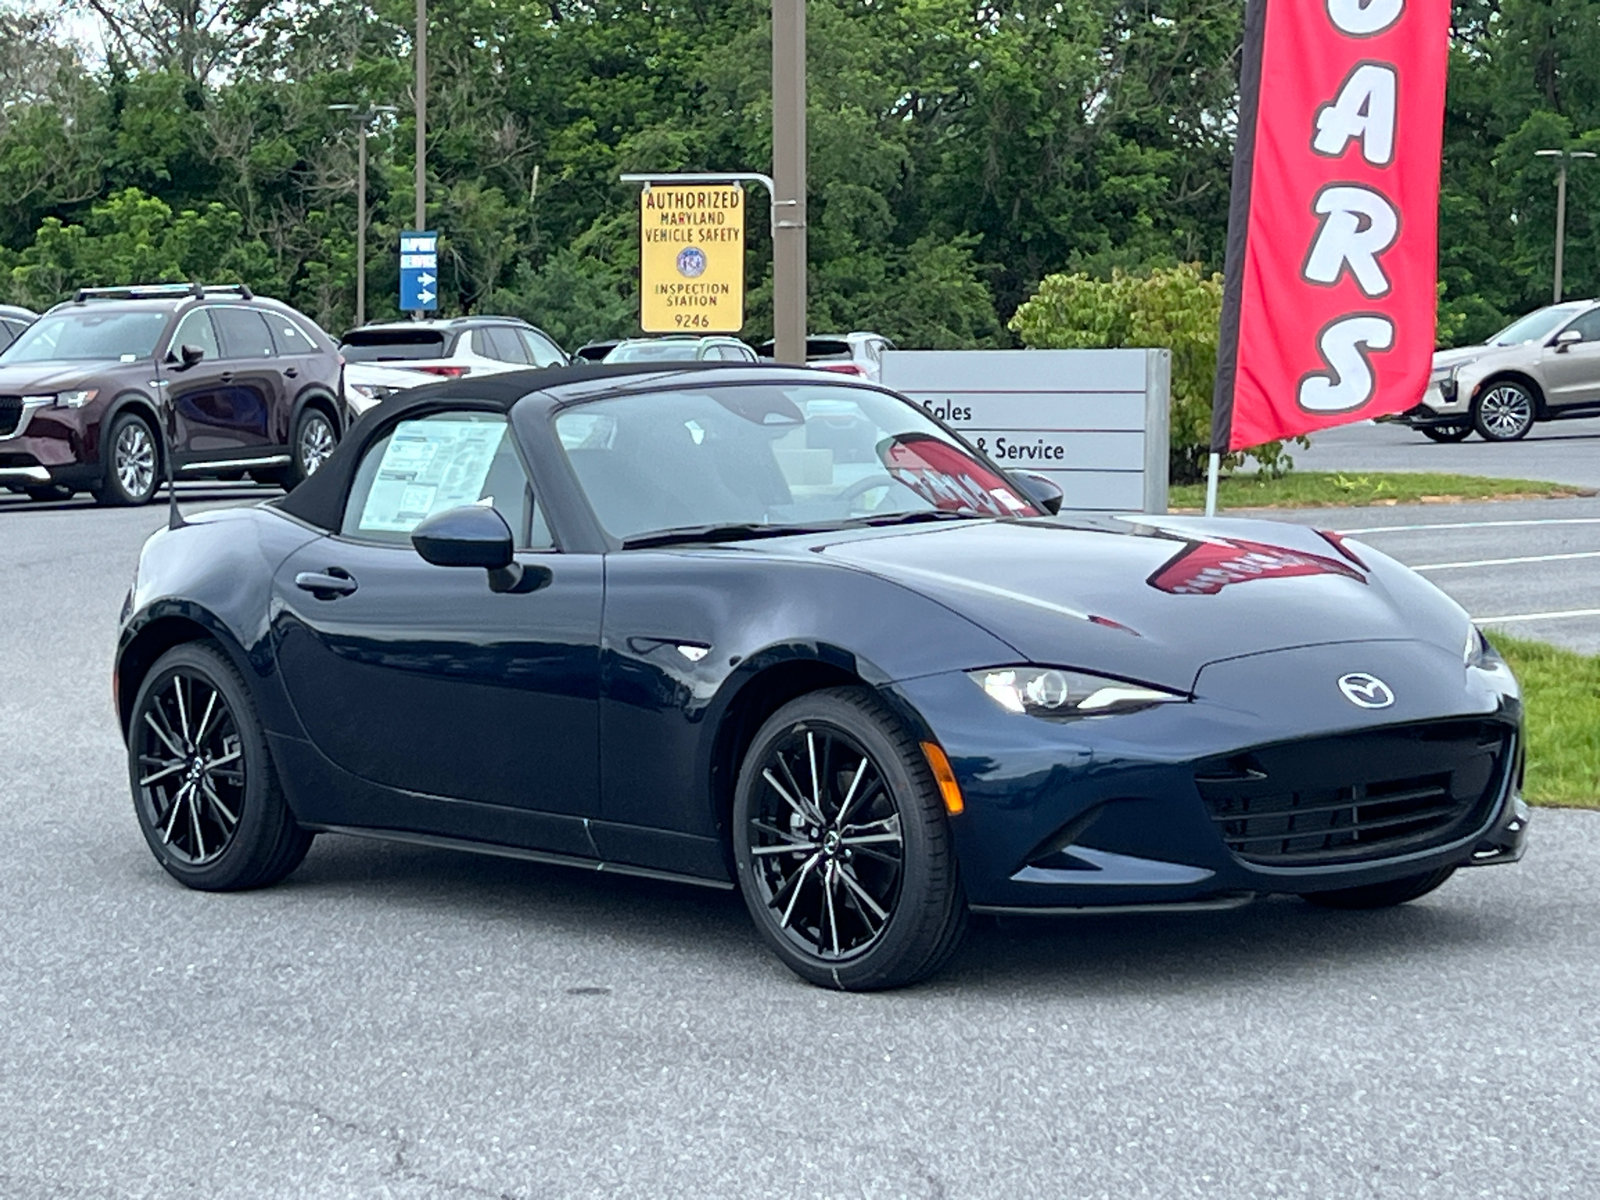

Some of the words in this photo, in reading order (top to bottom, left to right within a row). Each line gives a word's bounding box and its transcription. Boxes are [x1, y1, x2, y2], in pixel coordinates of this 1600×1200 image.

[646, 191, 740, 210] AUTHORIZED
[660, 212, 725, 226] MARYLAND
[645, 228, 693, 243] VEHICLE
[698, 227, 740, 243] SAFETY
[655, 283, 730, 295] INSPECTION
[666, 296, 717, 307] STATION
[674, 314, 710, 328] 9246
[977, 437, 989, 455] &
[995, 437, 1065, 460] Service
